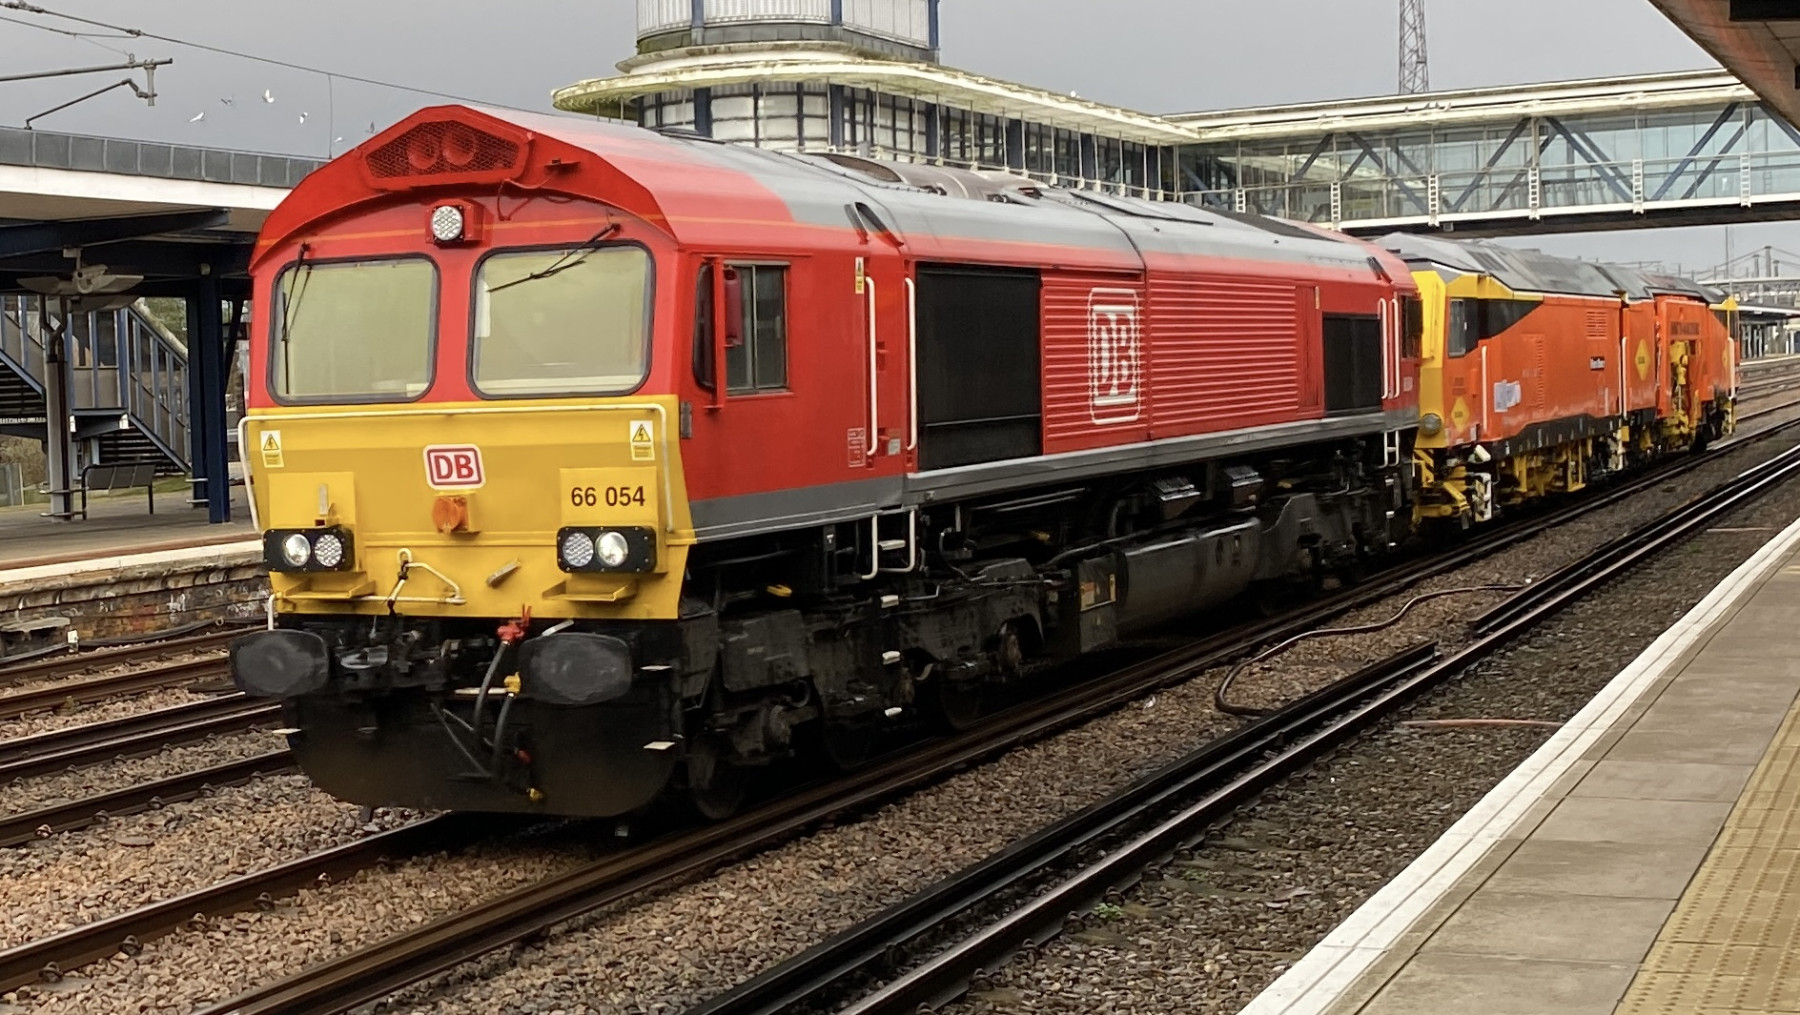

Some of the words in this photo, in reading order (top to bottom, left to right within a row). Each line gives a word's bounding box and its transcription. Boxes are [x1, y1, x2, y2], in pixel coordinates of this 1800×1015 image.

[433, 453, 475, 480] DB
[571, 486, 597, 507] 66
[605, 485, 646, 507] 054
